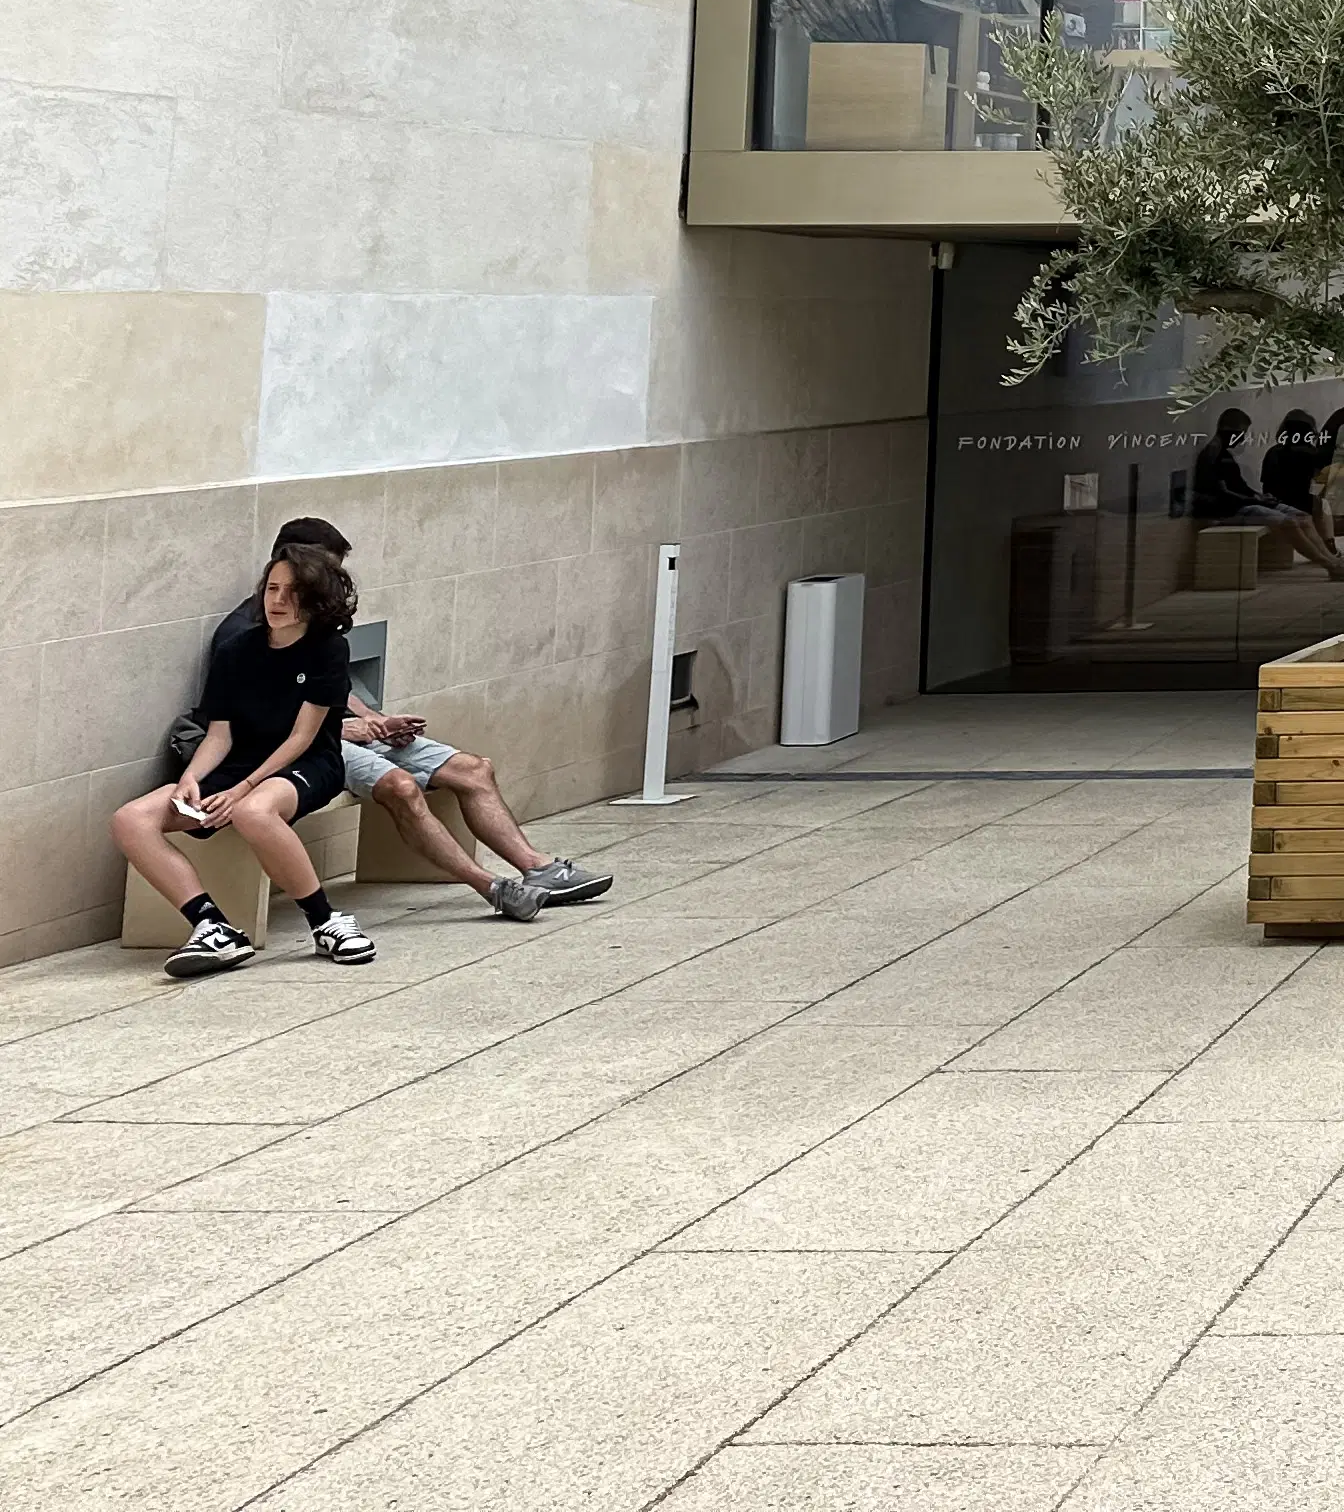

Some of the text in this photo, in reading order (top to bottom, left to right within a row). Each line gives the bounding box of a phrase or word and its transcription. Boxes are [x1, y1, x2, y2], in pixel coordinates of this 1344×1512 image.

[958, 431, 1081, 451] FONDATION
[1107, 430, 1208, 450] VINCENT
[1228, 430, 1270, 447] VAN
[1277, 429, 1332, 448] GOGH
